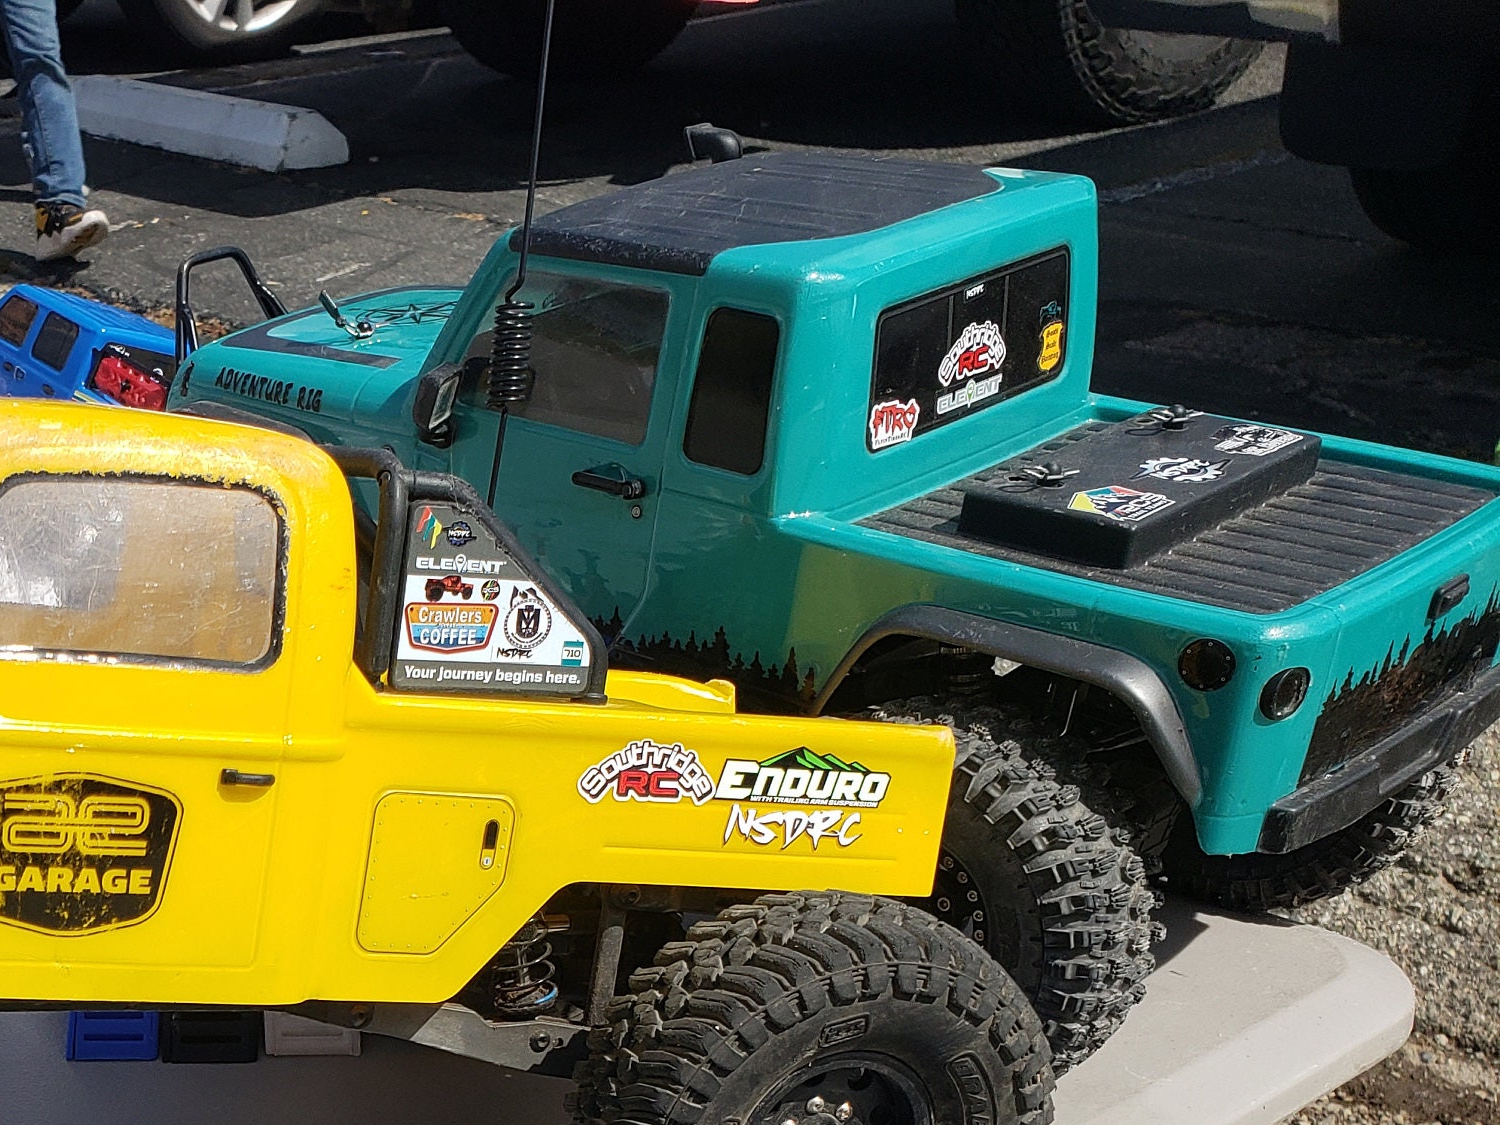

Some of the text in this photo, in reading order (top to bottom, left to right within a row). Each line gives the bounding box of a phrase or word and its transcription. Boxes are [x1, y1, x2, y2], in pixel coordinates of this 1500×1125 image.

[959, 346, 989, 374] RC
[215, 366, 294, 404] ADVENTURE
[297, 386, 323, 412] RIG
[418, 606, 482, 623] Crawlers
[420, 628, 477, 645] COFFEE
[404, 665, 436, 678] Your
[495, 669, 543, 684] begins
[545, 670, 581, 684] here.
[581, 741, 712, 803] Southridge
[617, 771, 678, 797] RC
[773, 796, 810, 804] TRAILING
[828, 800, 878, 808] SUSPENSION
[722, 804, 861, 850] NSDRC
